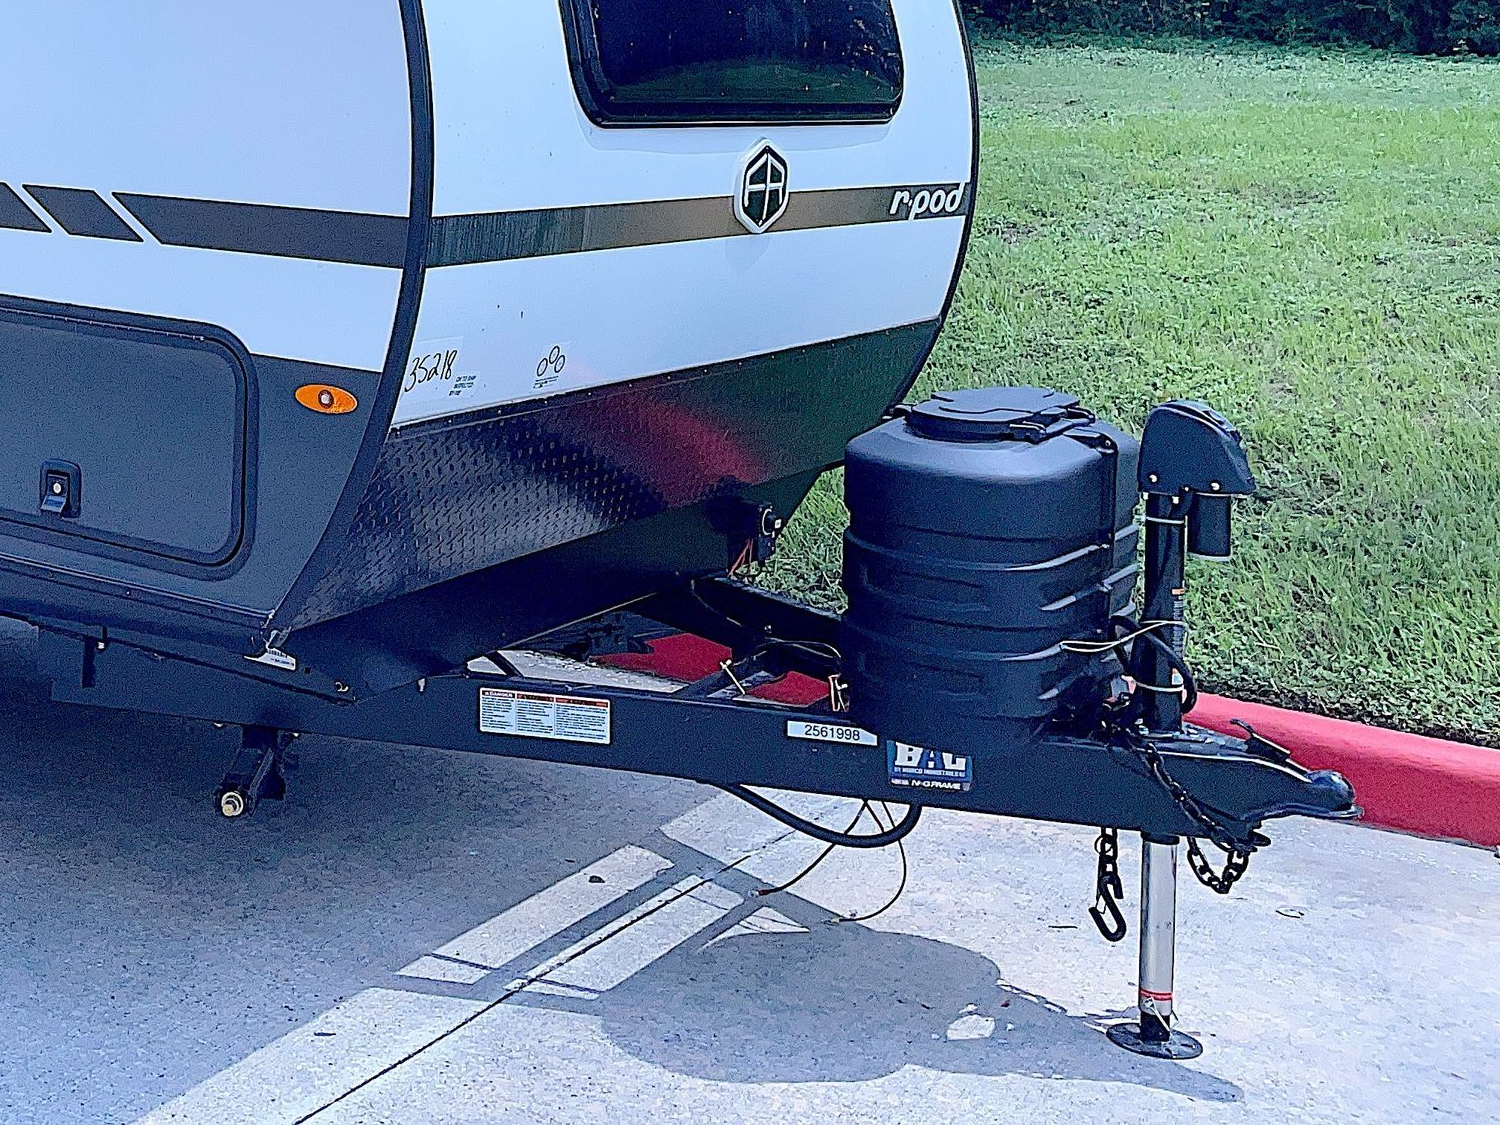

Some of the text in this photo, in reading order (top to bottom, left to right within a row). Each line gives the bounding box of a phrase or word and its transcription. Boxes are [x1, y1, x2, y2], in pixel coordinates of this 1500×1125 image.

[404, 349, 458, 393] 35218
[804, 724, 860, 741] 2561998
[895, 741, 967, 770] BAL
